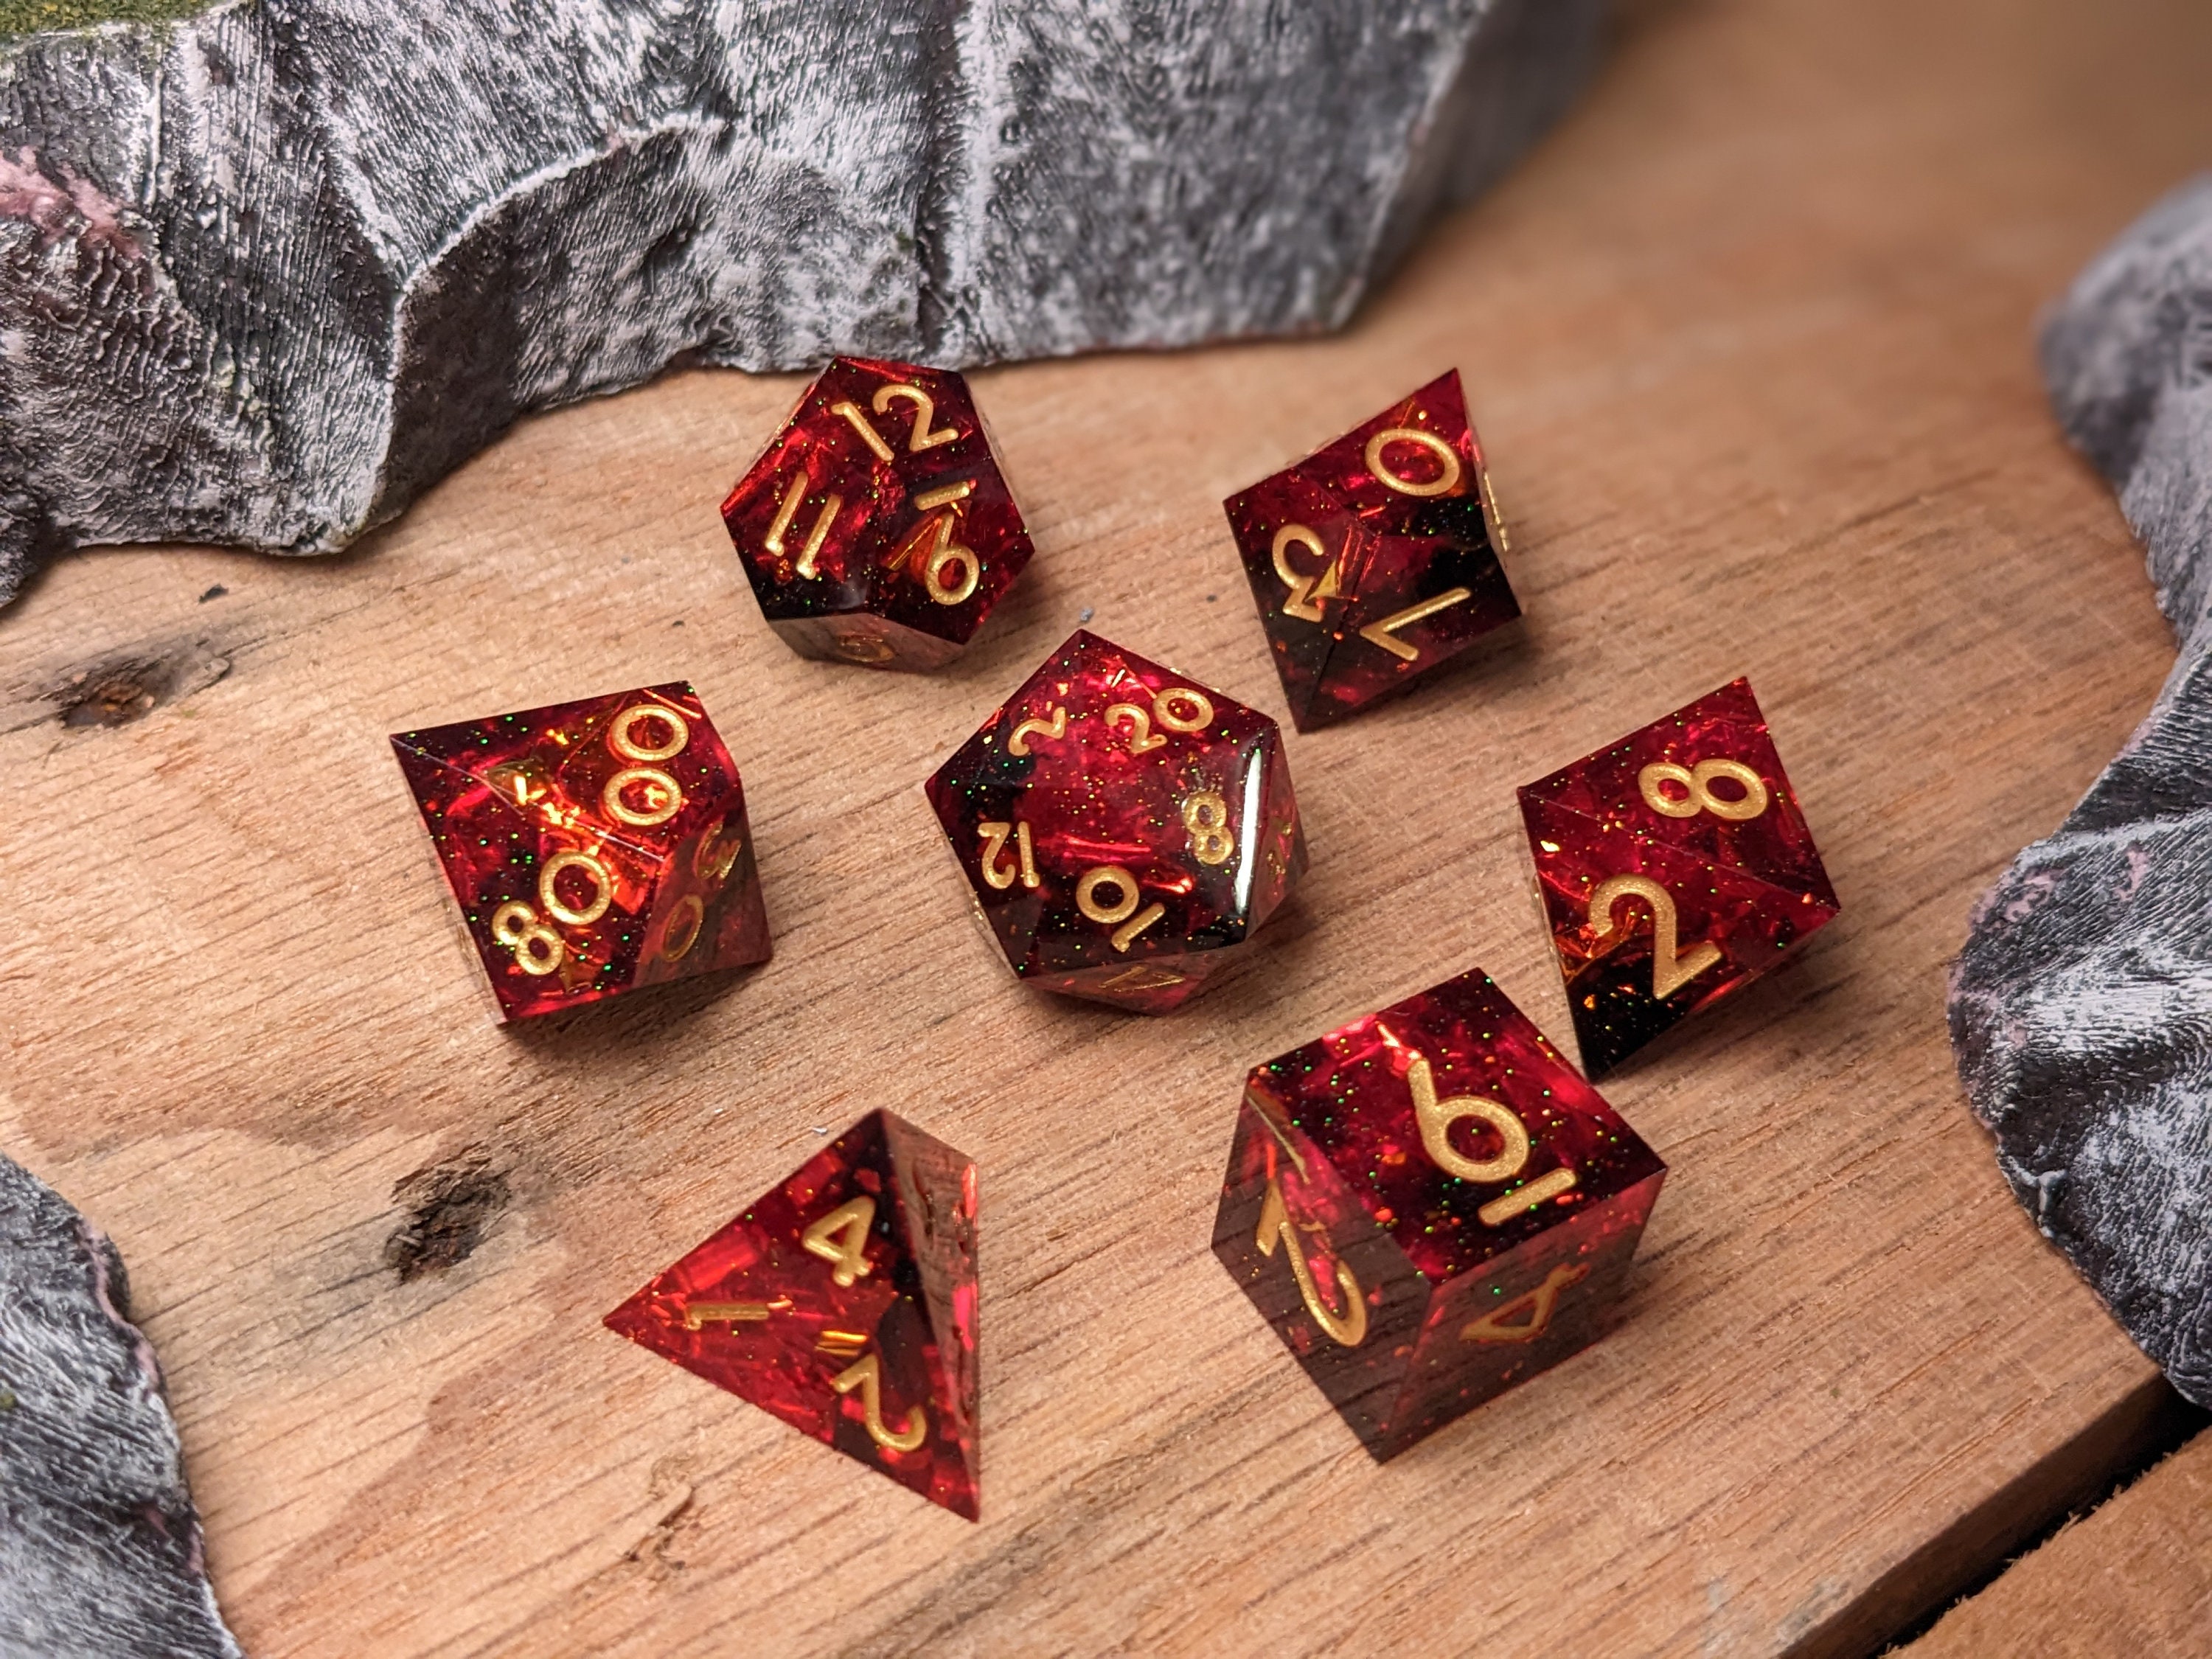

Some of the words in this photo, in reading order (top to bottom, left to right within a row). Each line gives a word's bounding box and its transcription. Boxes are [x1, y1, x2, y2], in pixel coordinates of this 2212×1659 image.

[832, 384, 959, 462] 12
[765, 471, 844, 580] 11
[1105, 687, 1214, 754] 20
[1183, 790, 1235, 865] 8
[1638, 758, 1767, 820] 8
[978, 821, 1040, 890] 12
[492, 850, 612, 975] 80
[1076, 866, 1166, 953] 10
[1588, 874, 1724, 1000] 2
[802, 1196, 877, 1287] 4
[833, 1354, 927, 1452] 2
